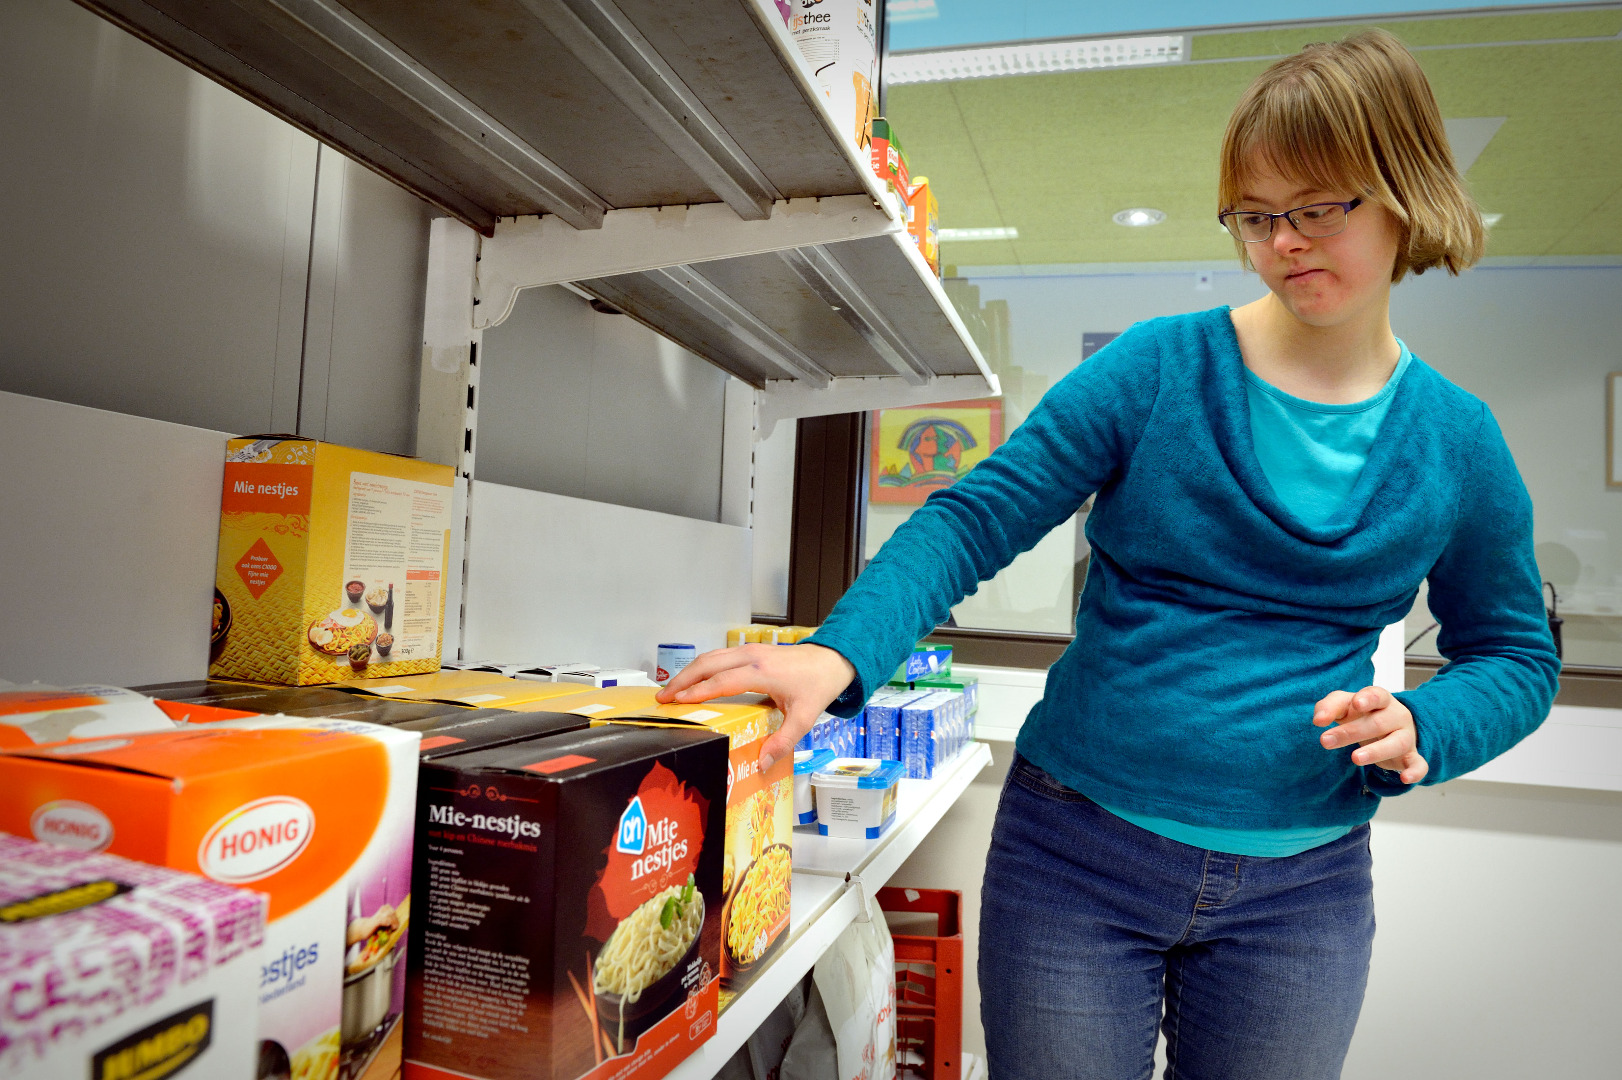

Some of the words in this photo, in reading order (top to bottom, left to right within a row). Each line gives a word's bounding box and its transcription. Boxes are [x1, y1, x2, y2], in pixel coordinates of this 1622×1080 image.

[793, 12, 831, 31] ijsthee
[233, 481, 254, 494] Mie
[257, 483, 299, 499] nestjes
[736, 760, 750, 783] Mie
[43, 817, 101, 842] HONIG
[428, 804, 541, 840] Mie-nestjes
[646, 816, 679, 850] Mie
[219, 818, 300, 861] HONIG
[630, 838, 688, 881] nestjes
